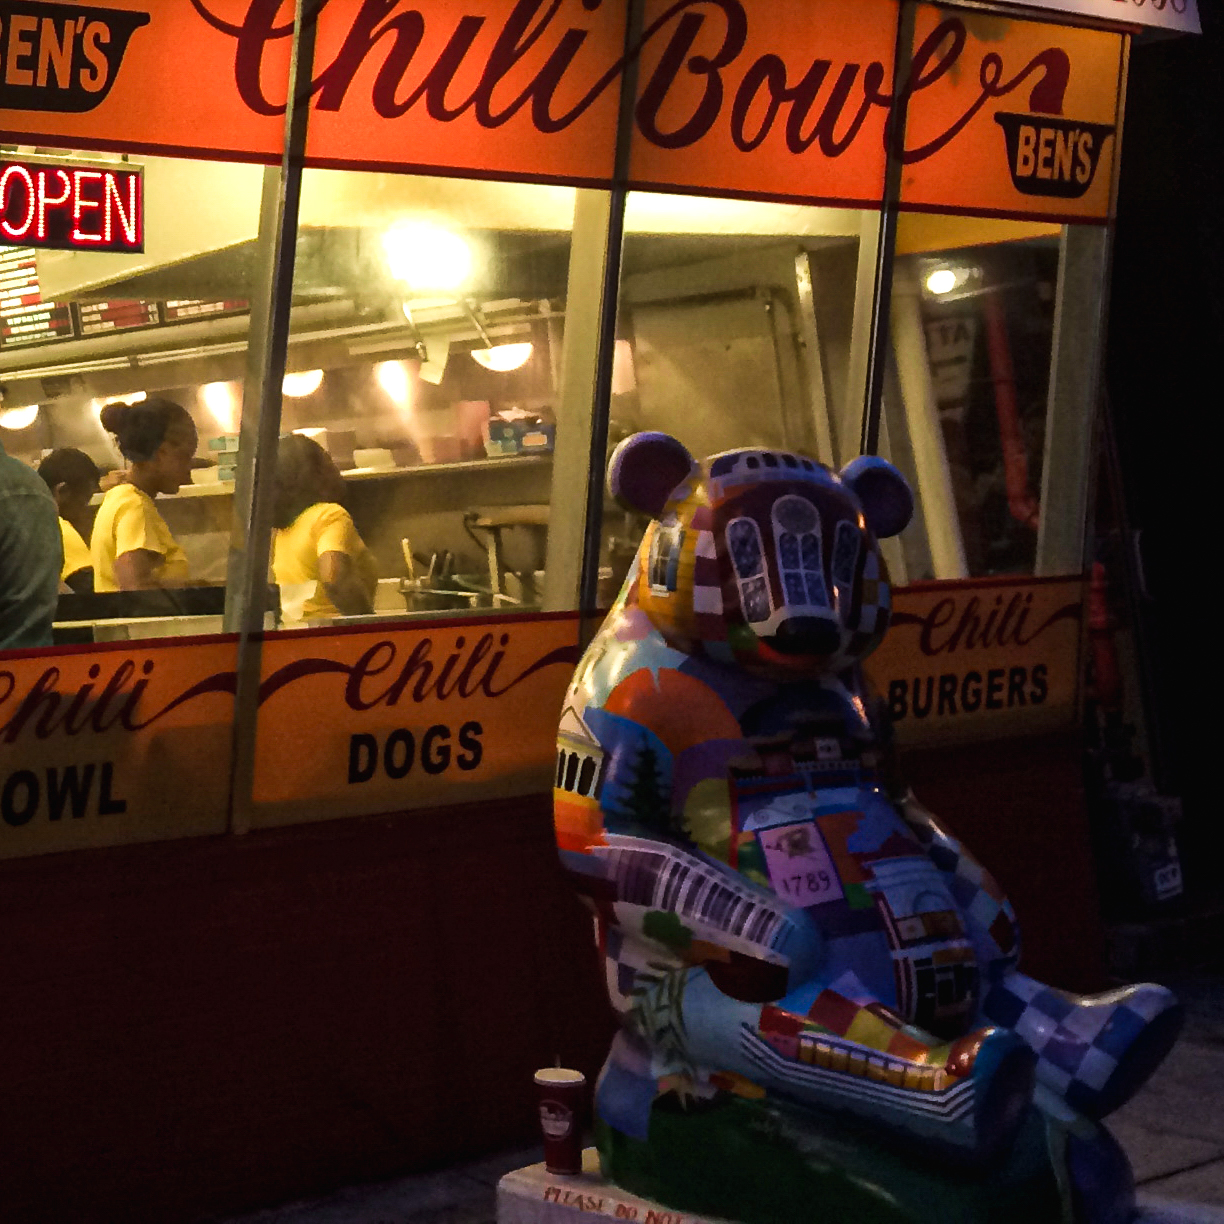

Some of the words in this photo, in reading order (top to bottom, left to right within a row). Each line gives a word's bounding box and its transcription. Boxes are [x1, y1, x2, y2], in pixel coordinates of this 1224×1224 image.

[1016, 125, 1095, 184] BEN'S
[918, 591, 1034, 656] Chili
[344, 632, 514, 711] Chili
[888, 663, 1049, 722] BURGERS
[348, 720, 485, 785] DOGS
[782, 869, 831, 897] 1789
